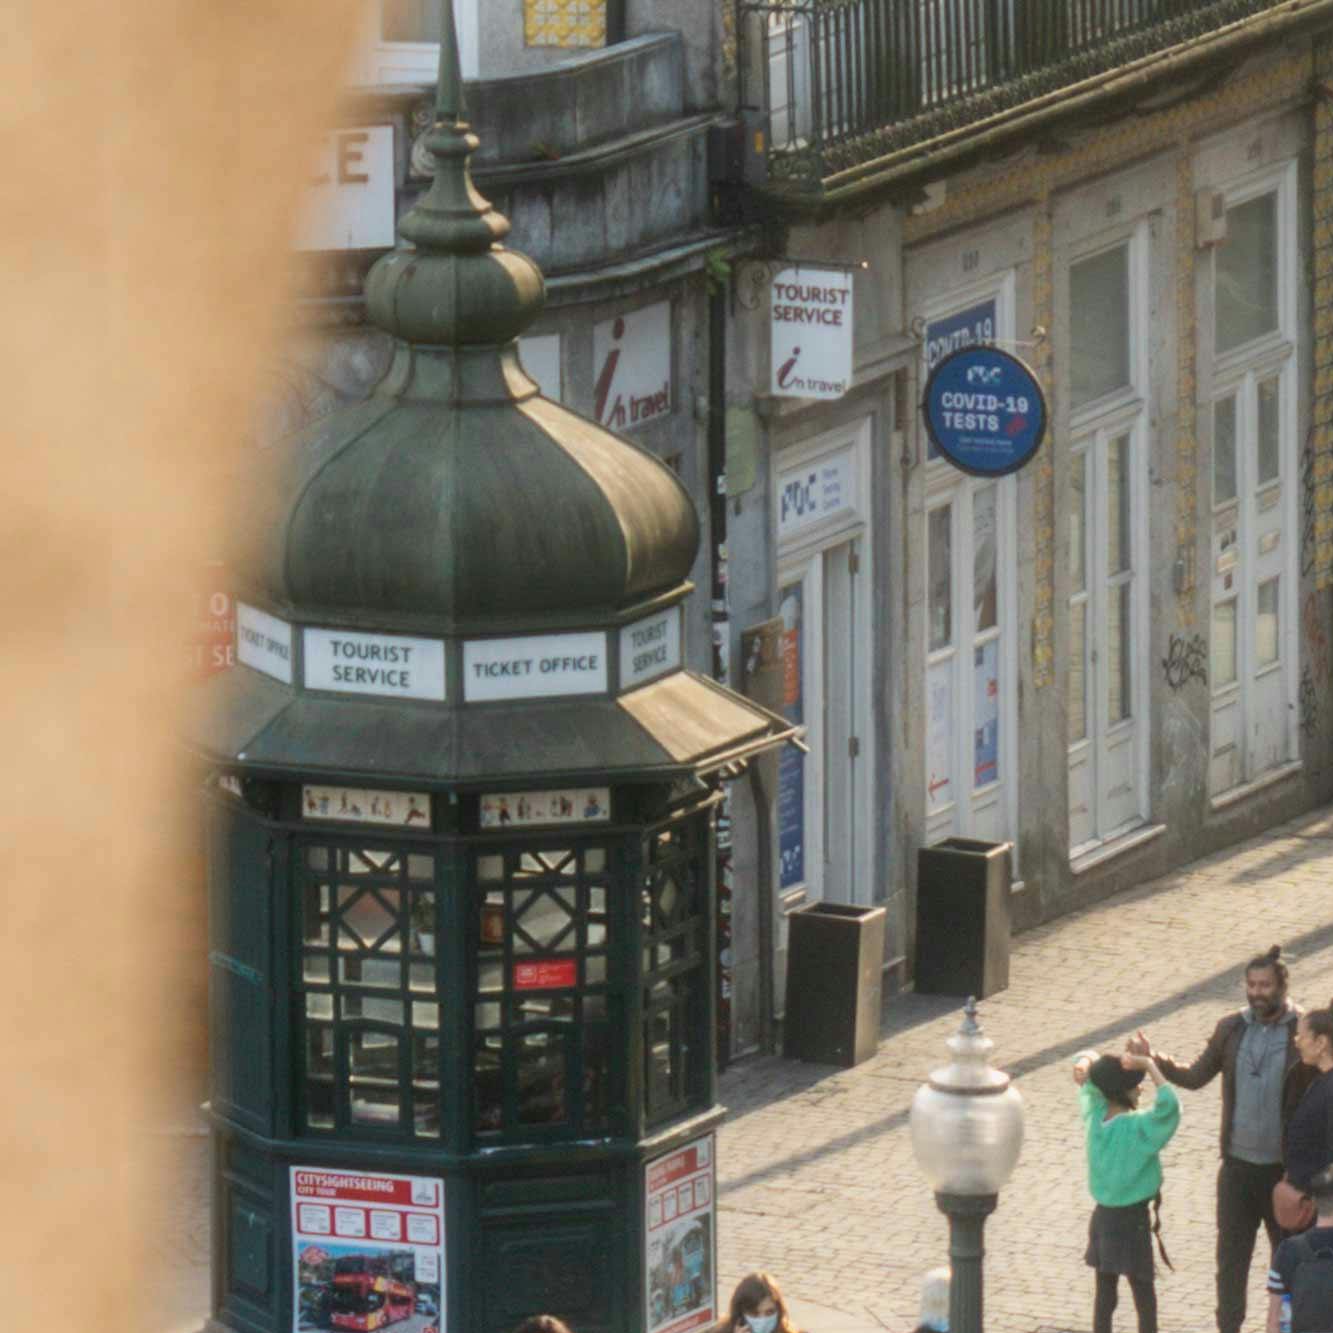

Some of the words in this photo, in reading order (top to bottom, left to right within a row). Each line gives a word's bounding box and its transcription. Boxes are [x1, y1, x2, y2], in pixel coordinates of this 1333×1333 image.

[773, 283, 850, 305] TOURIST
[773, 304, 843, 326] SERVICE
[941, 391, 1029, 414] COVID-19
[942, 410, 1000, 432] TESTS
[631, 619, 668, 648] TOURIST
[330, 639, 413, 664] TOURIST
[632, 644, 668, 674] SERVICE
[331, 664, 410, 688] SERVICE
[473, 659, 533, 679] TICKET
[539, 655, 599, 674] OFFICE
[297, 1171, 395, 1193] CITYSIGHTSEEING
